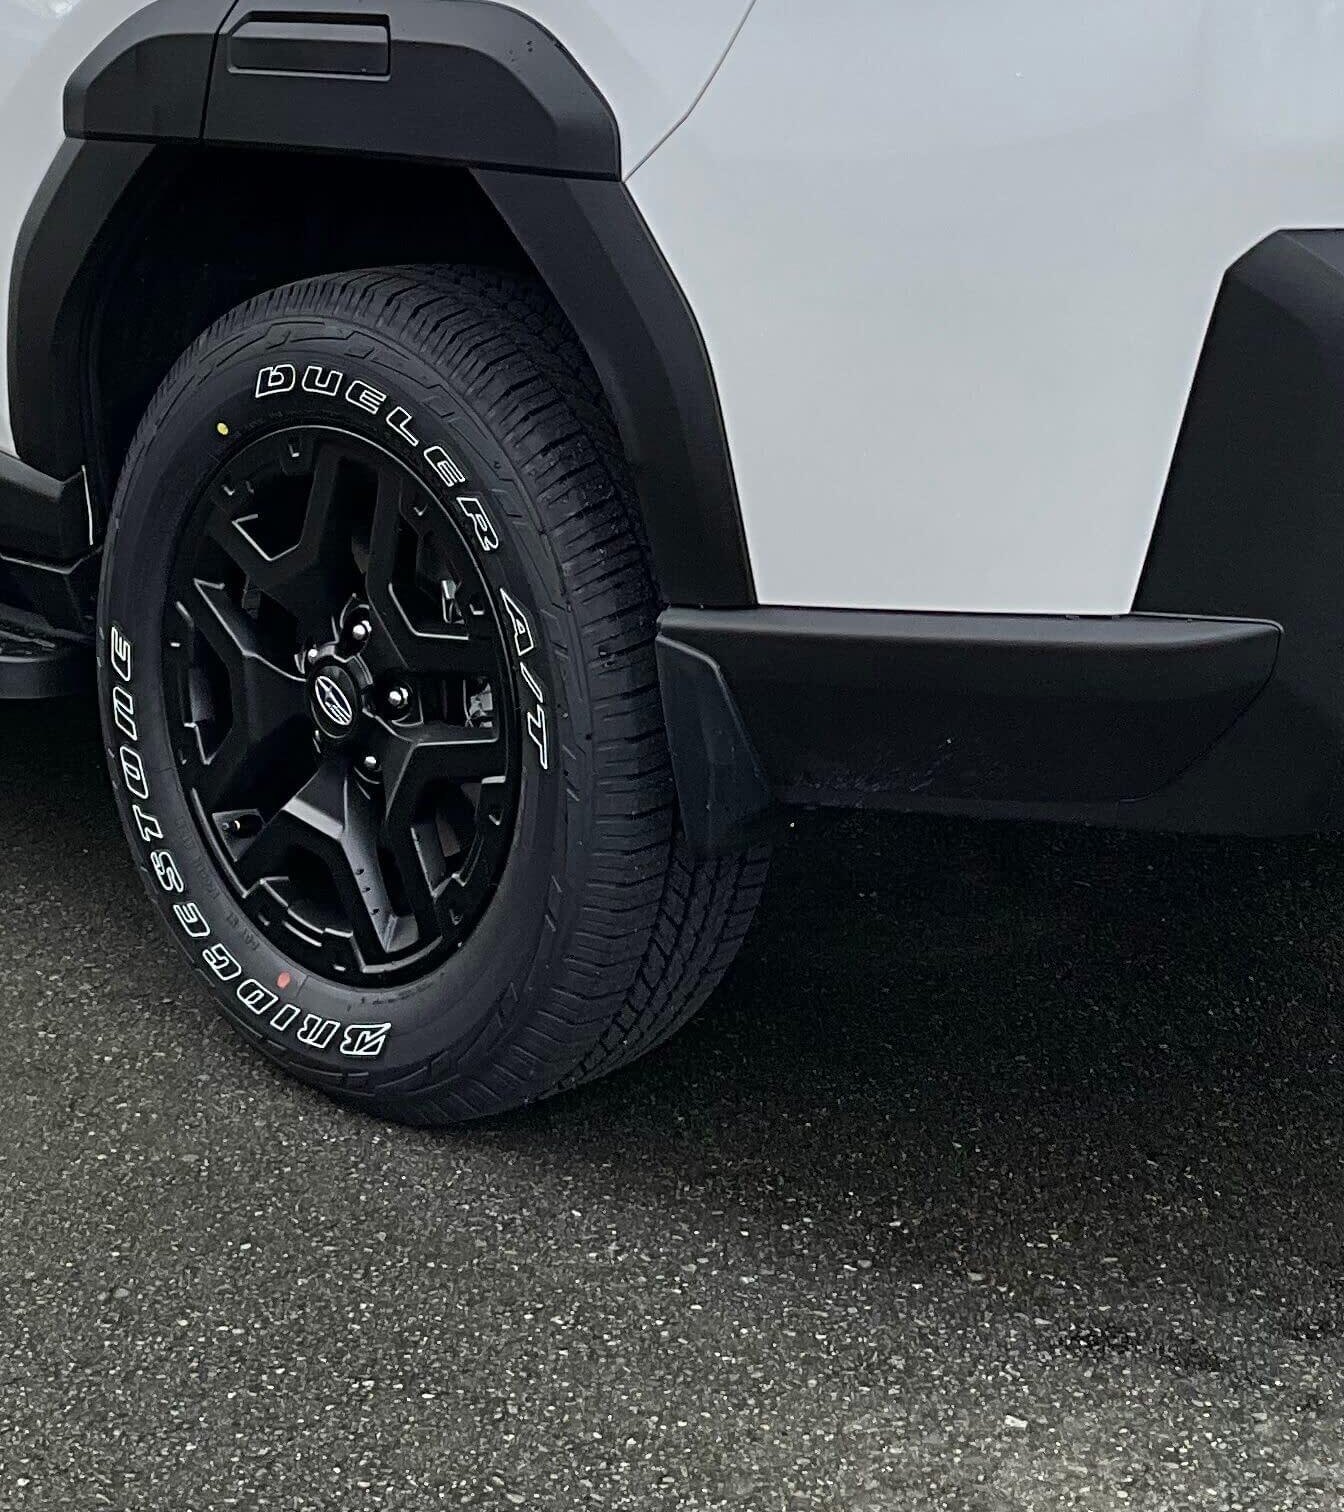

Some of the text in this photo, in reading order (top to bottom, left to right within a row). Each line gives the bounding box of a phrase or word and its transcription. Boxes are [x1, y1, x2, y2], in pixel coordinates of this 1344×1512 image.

[255, 363, 549, 770] DUELER A/T
[110, 625, 392, 1057] BRIDGESTONE
